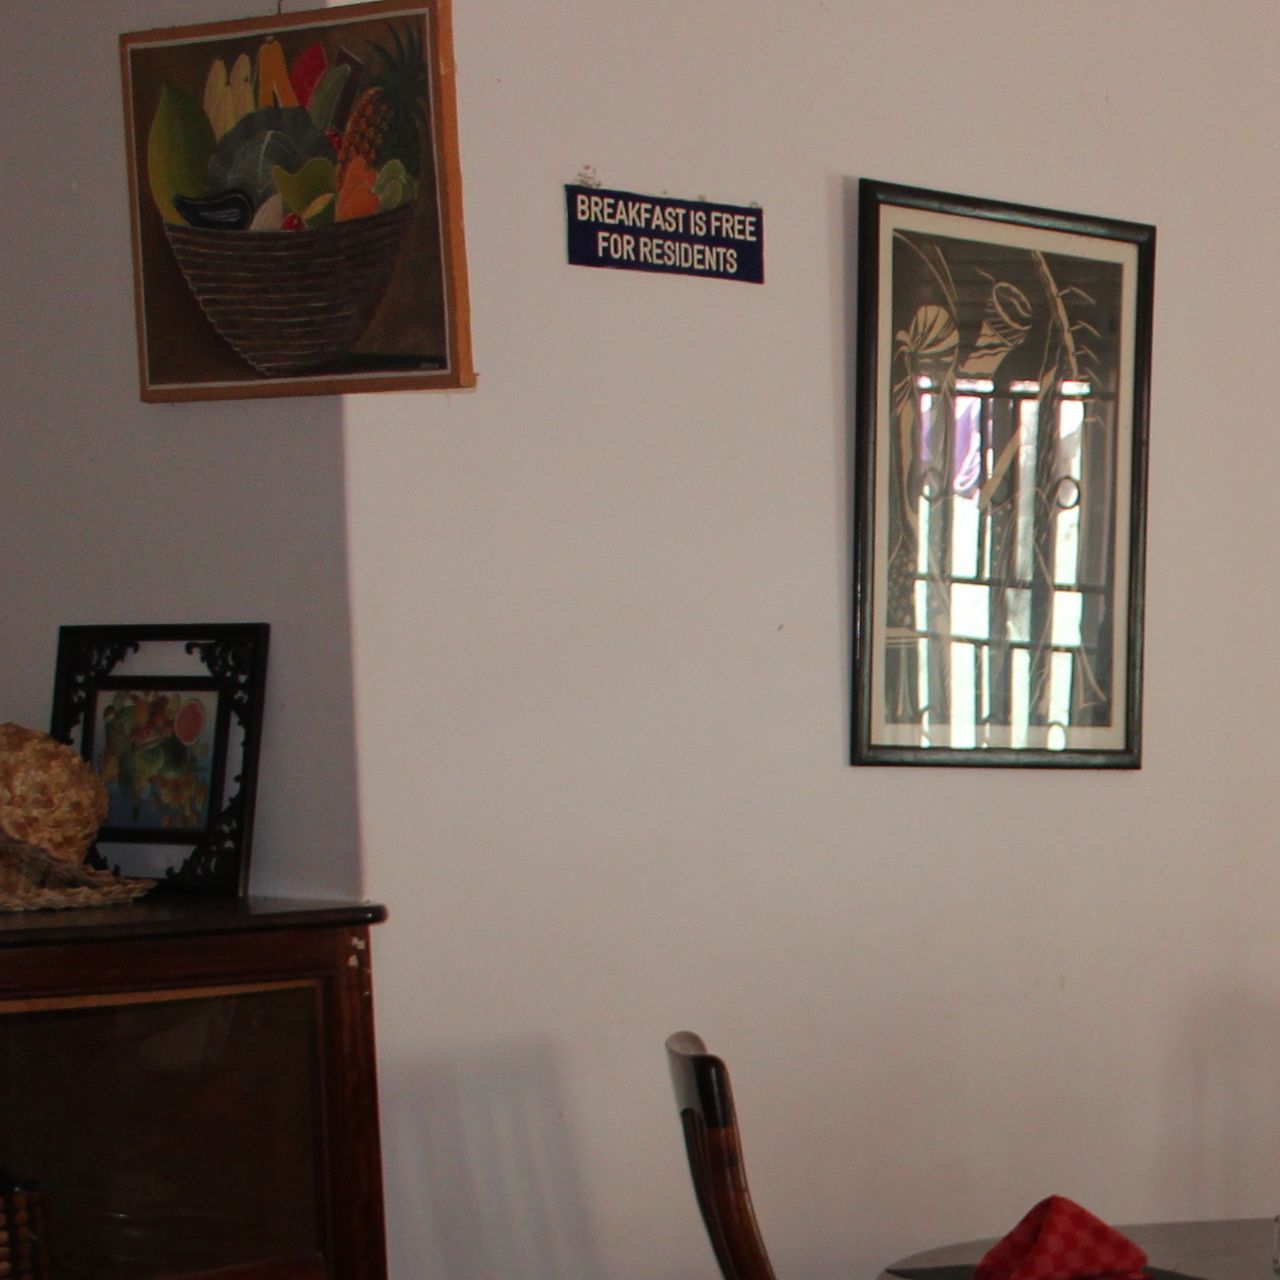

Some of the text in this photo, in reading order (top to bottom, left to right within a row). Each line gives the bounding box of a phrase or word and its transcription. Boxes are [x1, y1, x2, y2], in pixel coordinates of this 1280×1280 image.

[577, 194, 757, 241] BREAKFAST IS FREE
[598, 232, 737, 273] FOR RESIDENTS
